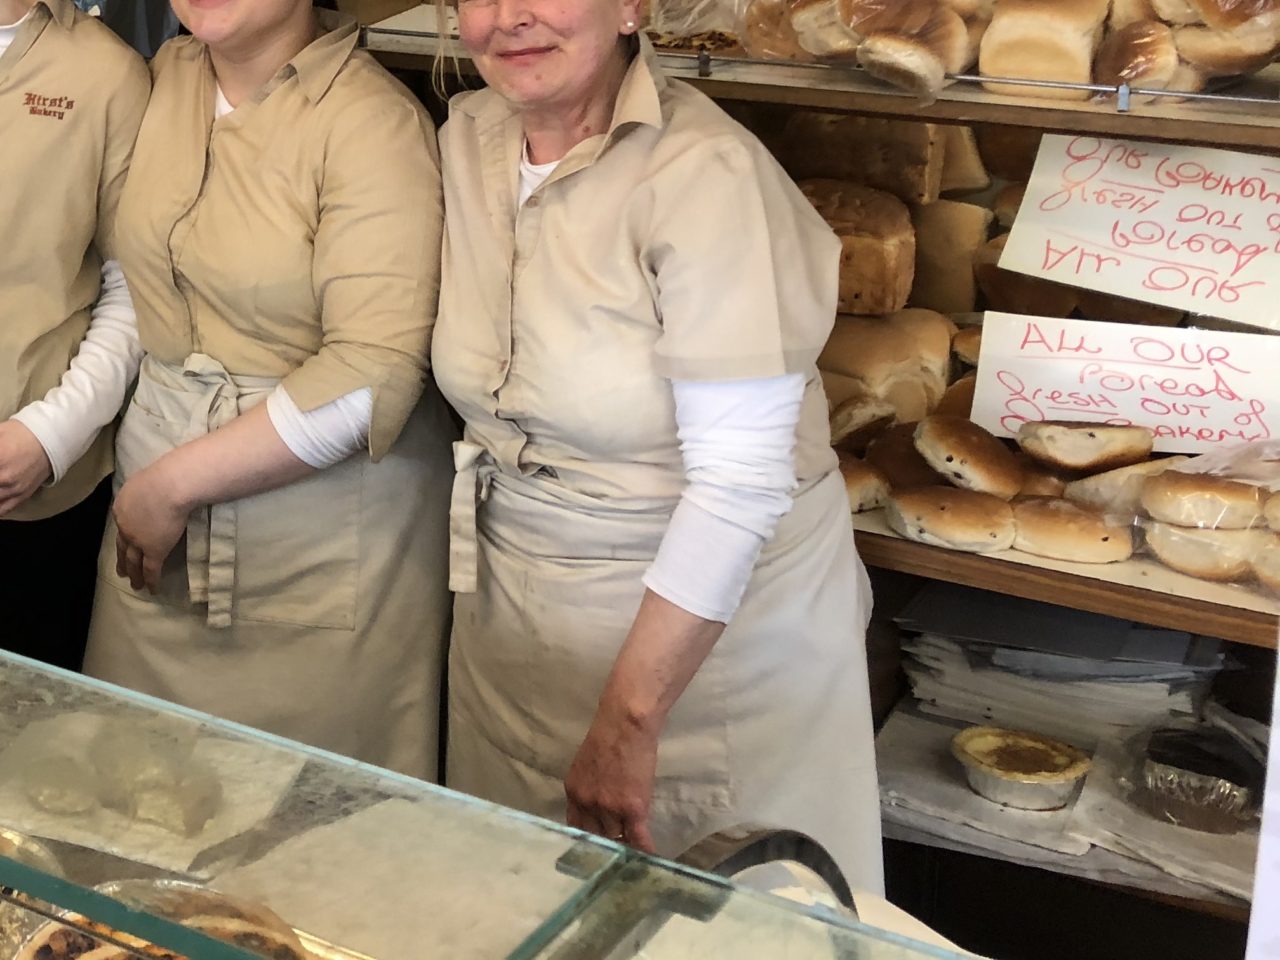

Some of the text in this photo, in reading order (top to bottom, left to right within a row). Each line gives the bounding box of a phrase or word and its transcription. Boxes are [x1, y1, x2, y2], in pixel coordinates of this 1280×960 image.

[22, 93, 76, 110] Hirst's
[28, 107, 65, 120] Bakery
[1020, 322, 1250, 374] ALL OUR
[1140, 397, 1211, 418] OUT
[1234, 399, 1271, 439] of
